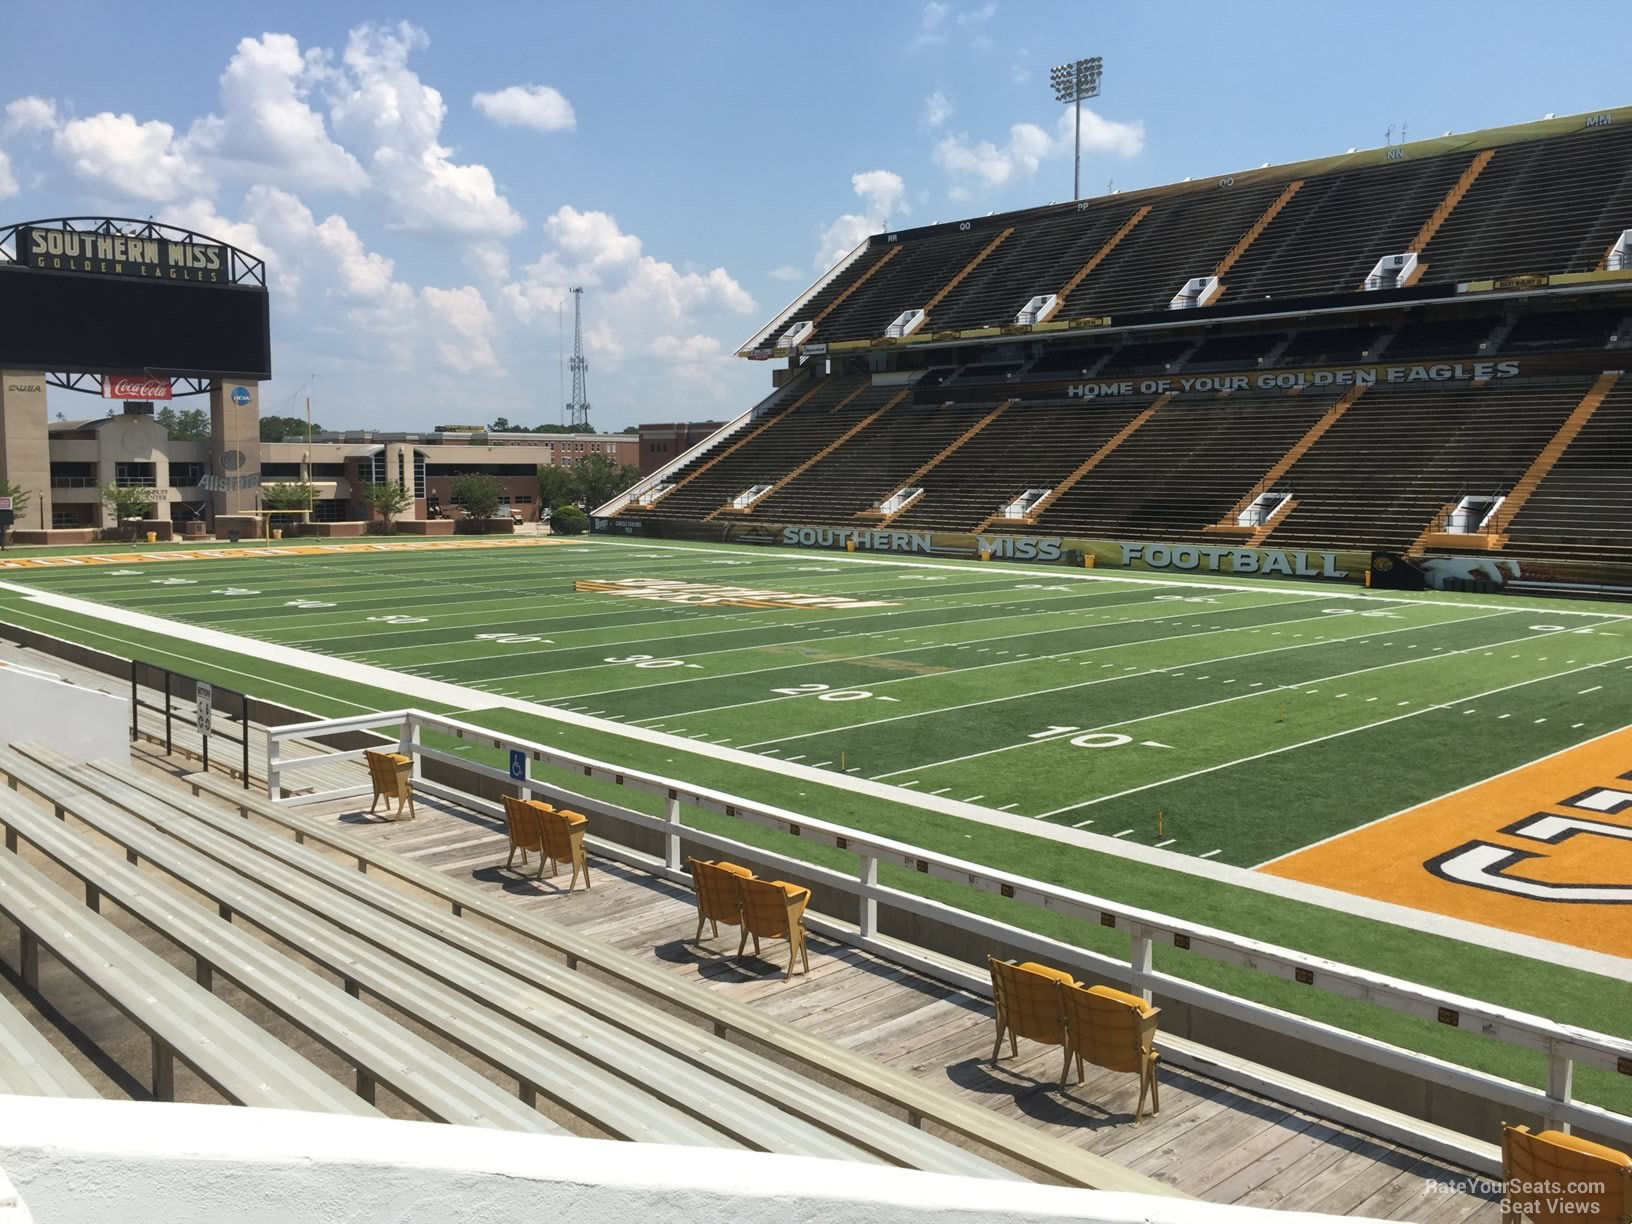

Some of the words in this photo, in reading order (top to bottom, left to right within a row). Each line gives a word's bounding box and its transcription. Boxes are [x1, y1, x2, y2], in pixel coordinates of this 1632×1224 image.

[1586, 113, 1612, 128] MM
[1386, 149, 1404, 160] NN
[1077, 202, 1089, 212] PP
[31, 229, 159, 264] SOUTHERN
[168, 241, 221, 270] MISS
[38, 257, 123, 274] GOLDEN
[141, 265, 217, 282] EAGLES
[1067, 381, 1134, 398] HOME
[1140, 379, 1173, 394] OF
[1179, 376, 1249, 392] YOUR
[1257, 368, 1377, 389] GOLDEN
[1384, 360, 1520, 383] EAGLES
[783, 526, 932, 553] SOUTHERN
[976, 536, 1063, 561] MISS
[1120, 543, 1349, 578] FOOTBALL
[603, 654, 685, 668] 30
[770, 683, 873, 701] 20
[1027, 725, 1133, 747] 10
